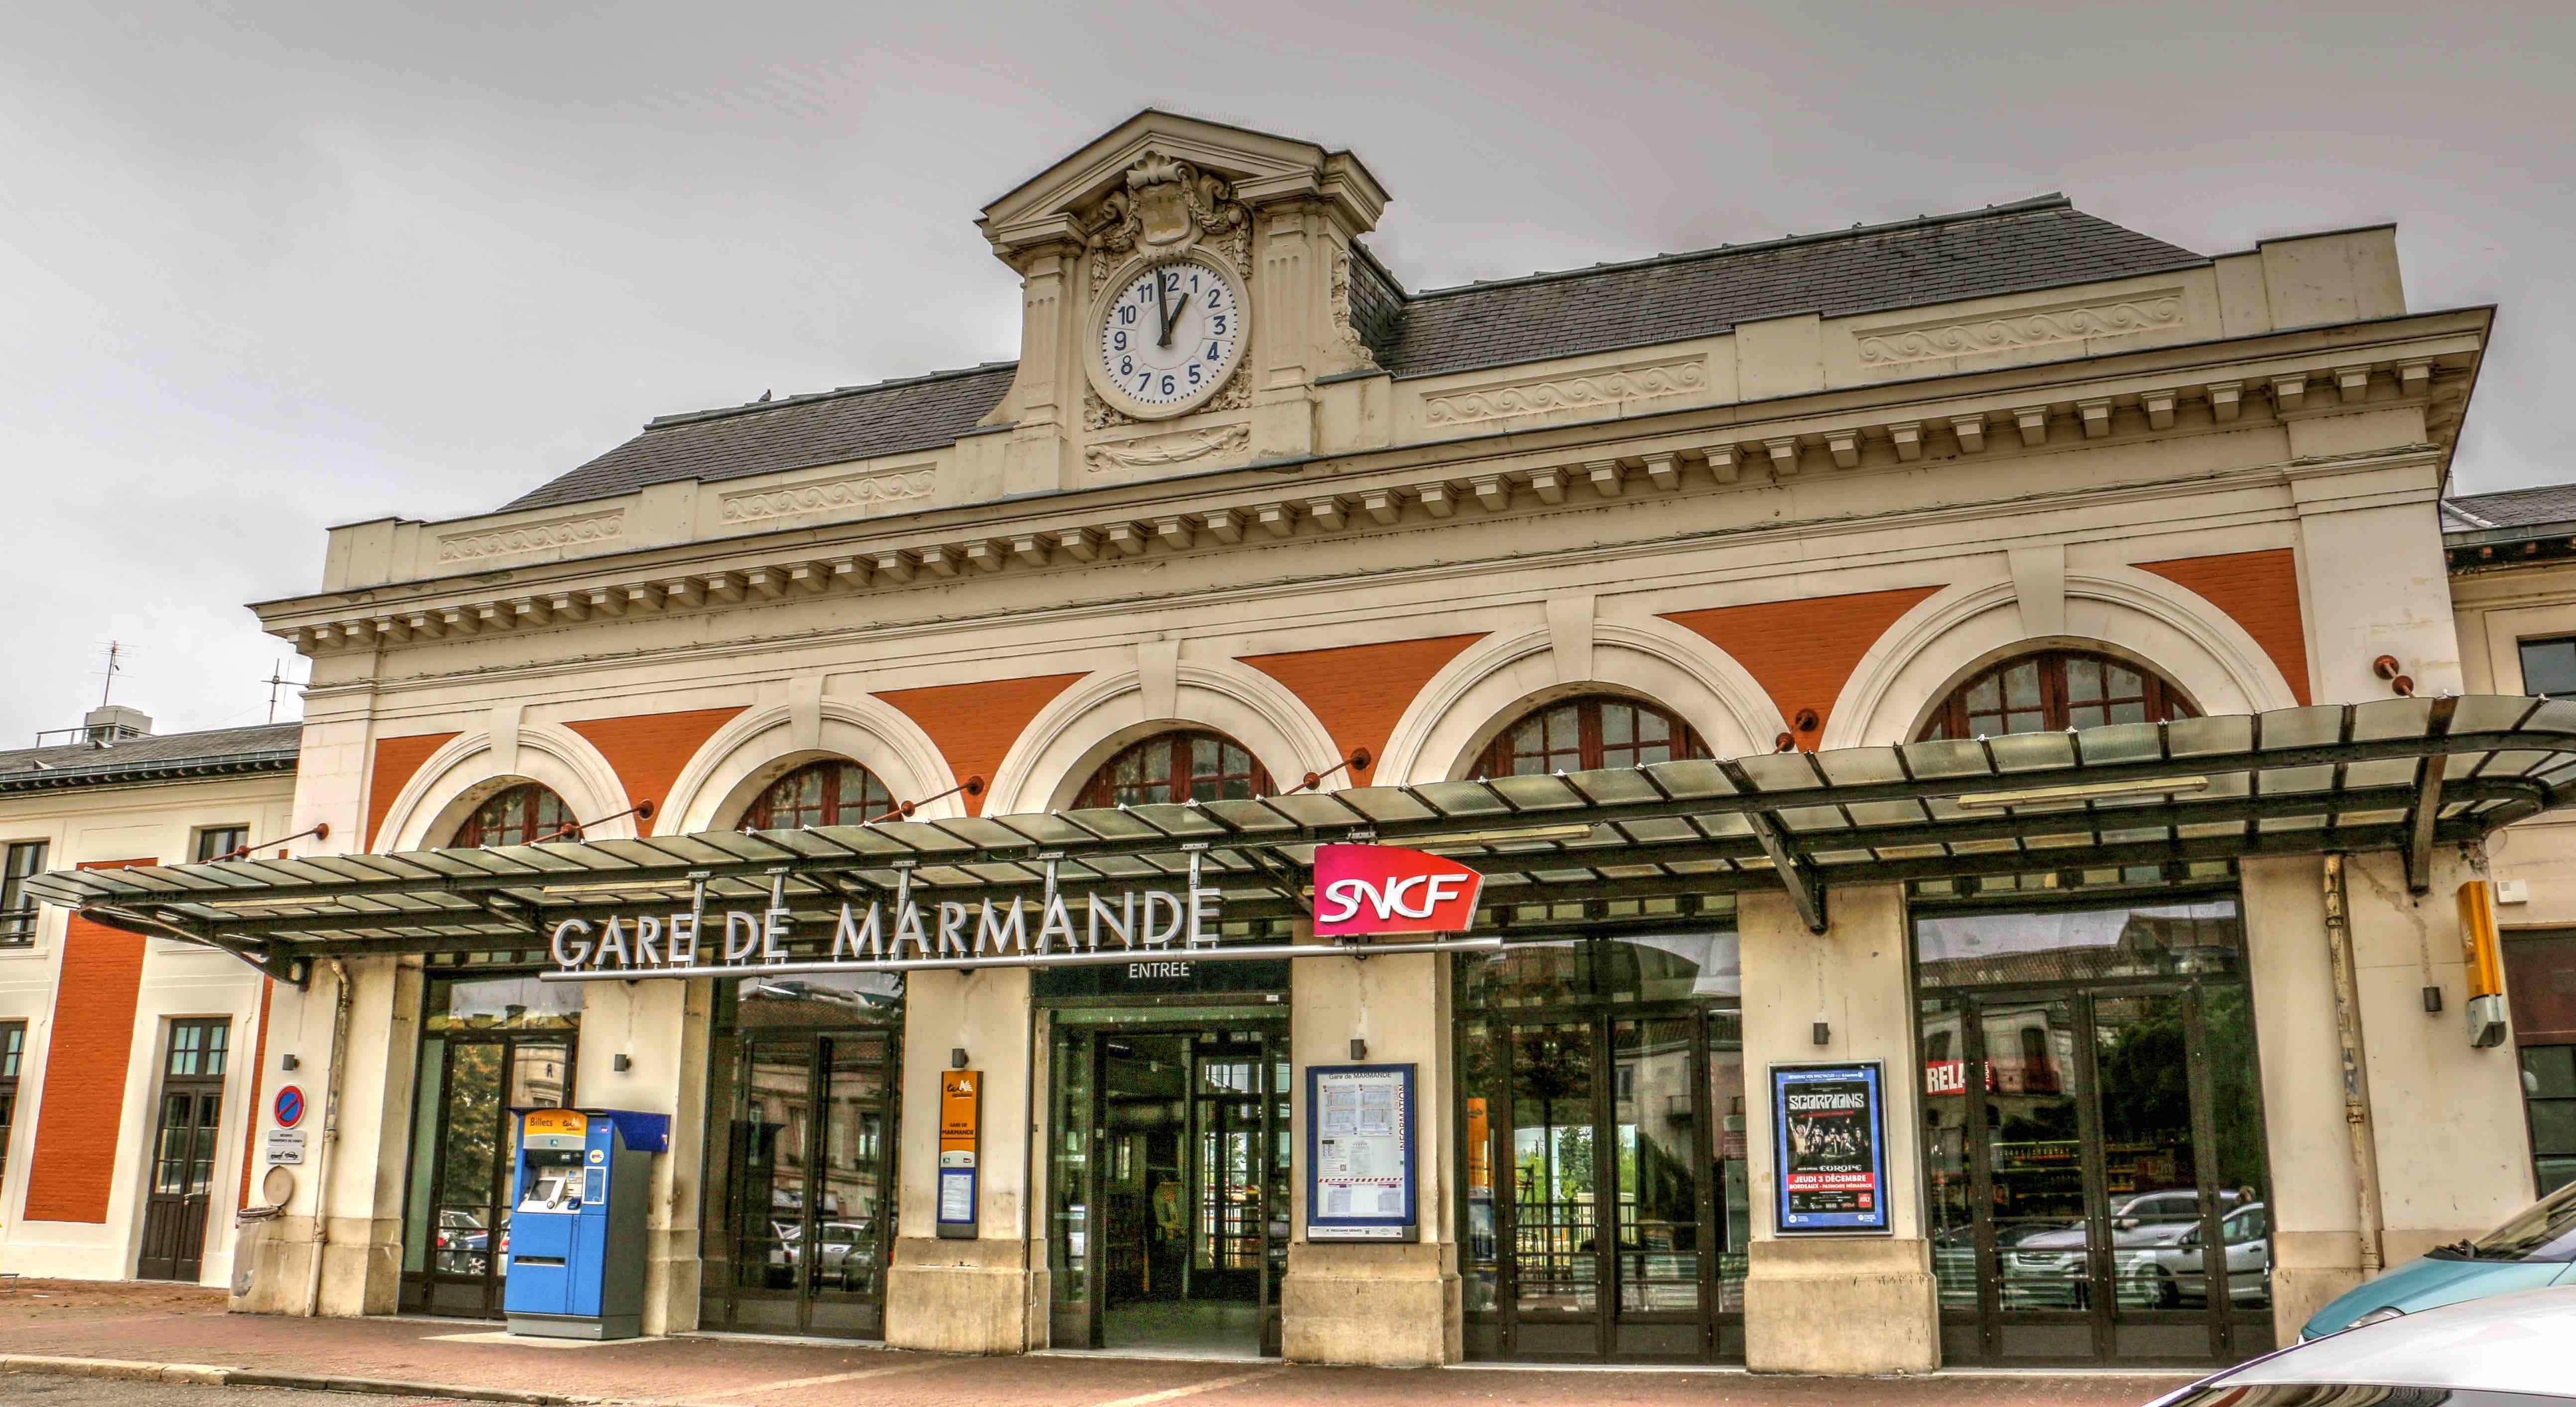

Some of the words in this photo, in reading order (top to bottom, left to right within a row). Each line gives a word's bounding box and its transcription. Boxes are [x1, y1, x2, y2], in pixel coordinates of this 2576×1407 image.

[1137, 283, 1153, 303] 11
[1190, 274, 1197, 293] 1
[1208, 289, 1221, 308] 2
[1118, 305, 1136, 325] 10
[1214, 316, 1226, 335] 3
[1114, 331, 1126, 351] 9
[1207, 342, 1219, 360] 4
[1121, 355, 1132, 375] 8
[1189, 365, 1201, 384] 5
[1139, 373, 1151, 391] 7
[1162, 376, 1175, 395] 6
[1319, 874, 1469, 923] SNCF
[552, 913, 694, 967] GARE
[726, 908, 791, 961] DE
[832, 888, 1221, 958] MARMANDE
[1927, 1063, 1965, 1092] RELA
[1789, 1093, 1864, 1110] SCORPIONS
[1825, 1173, 1866, 1182] DÉCEMBRE
